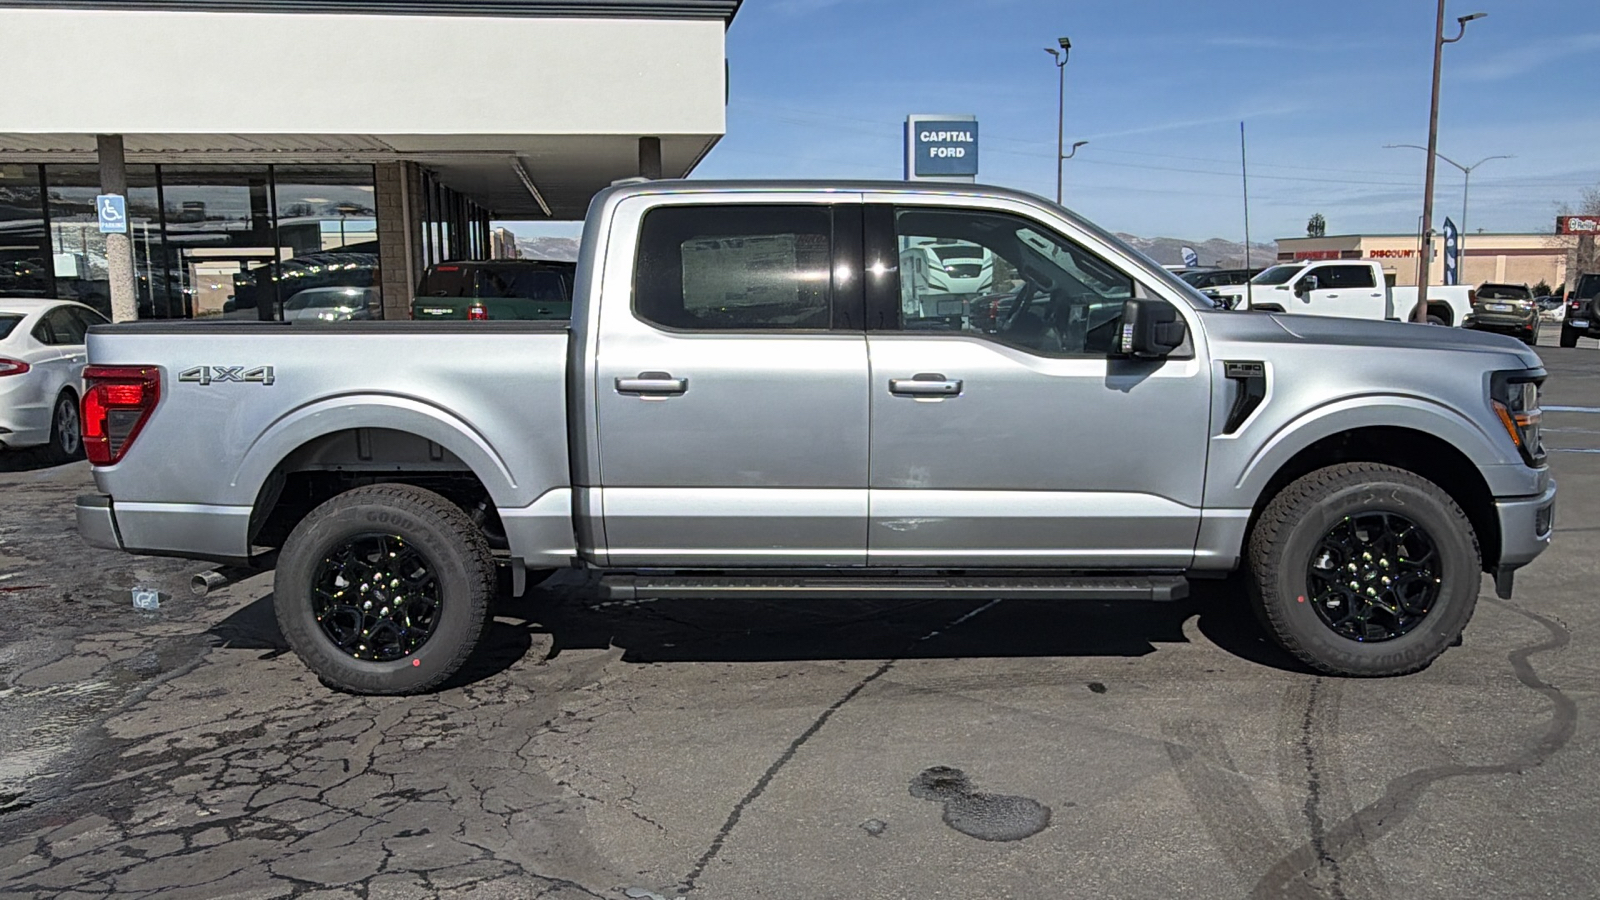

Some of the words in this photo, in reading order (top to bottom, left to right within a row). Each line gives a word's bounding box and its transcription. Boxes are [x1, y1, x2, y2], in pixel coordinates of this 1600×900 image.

[920, 131, 974, 142] CAPITAL
[930, 147, 965, 158] FORD
[1370, 249, 1416, 258] DISCOUNT
